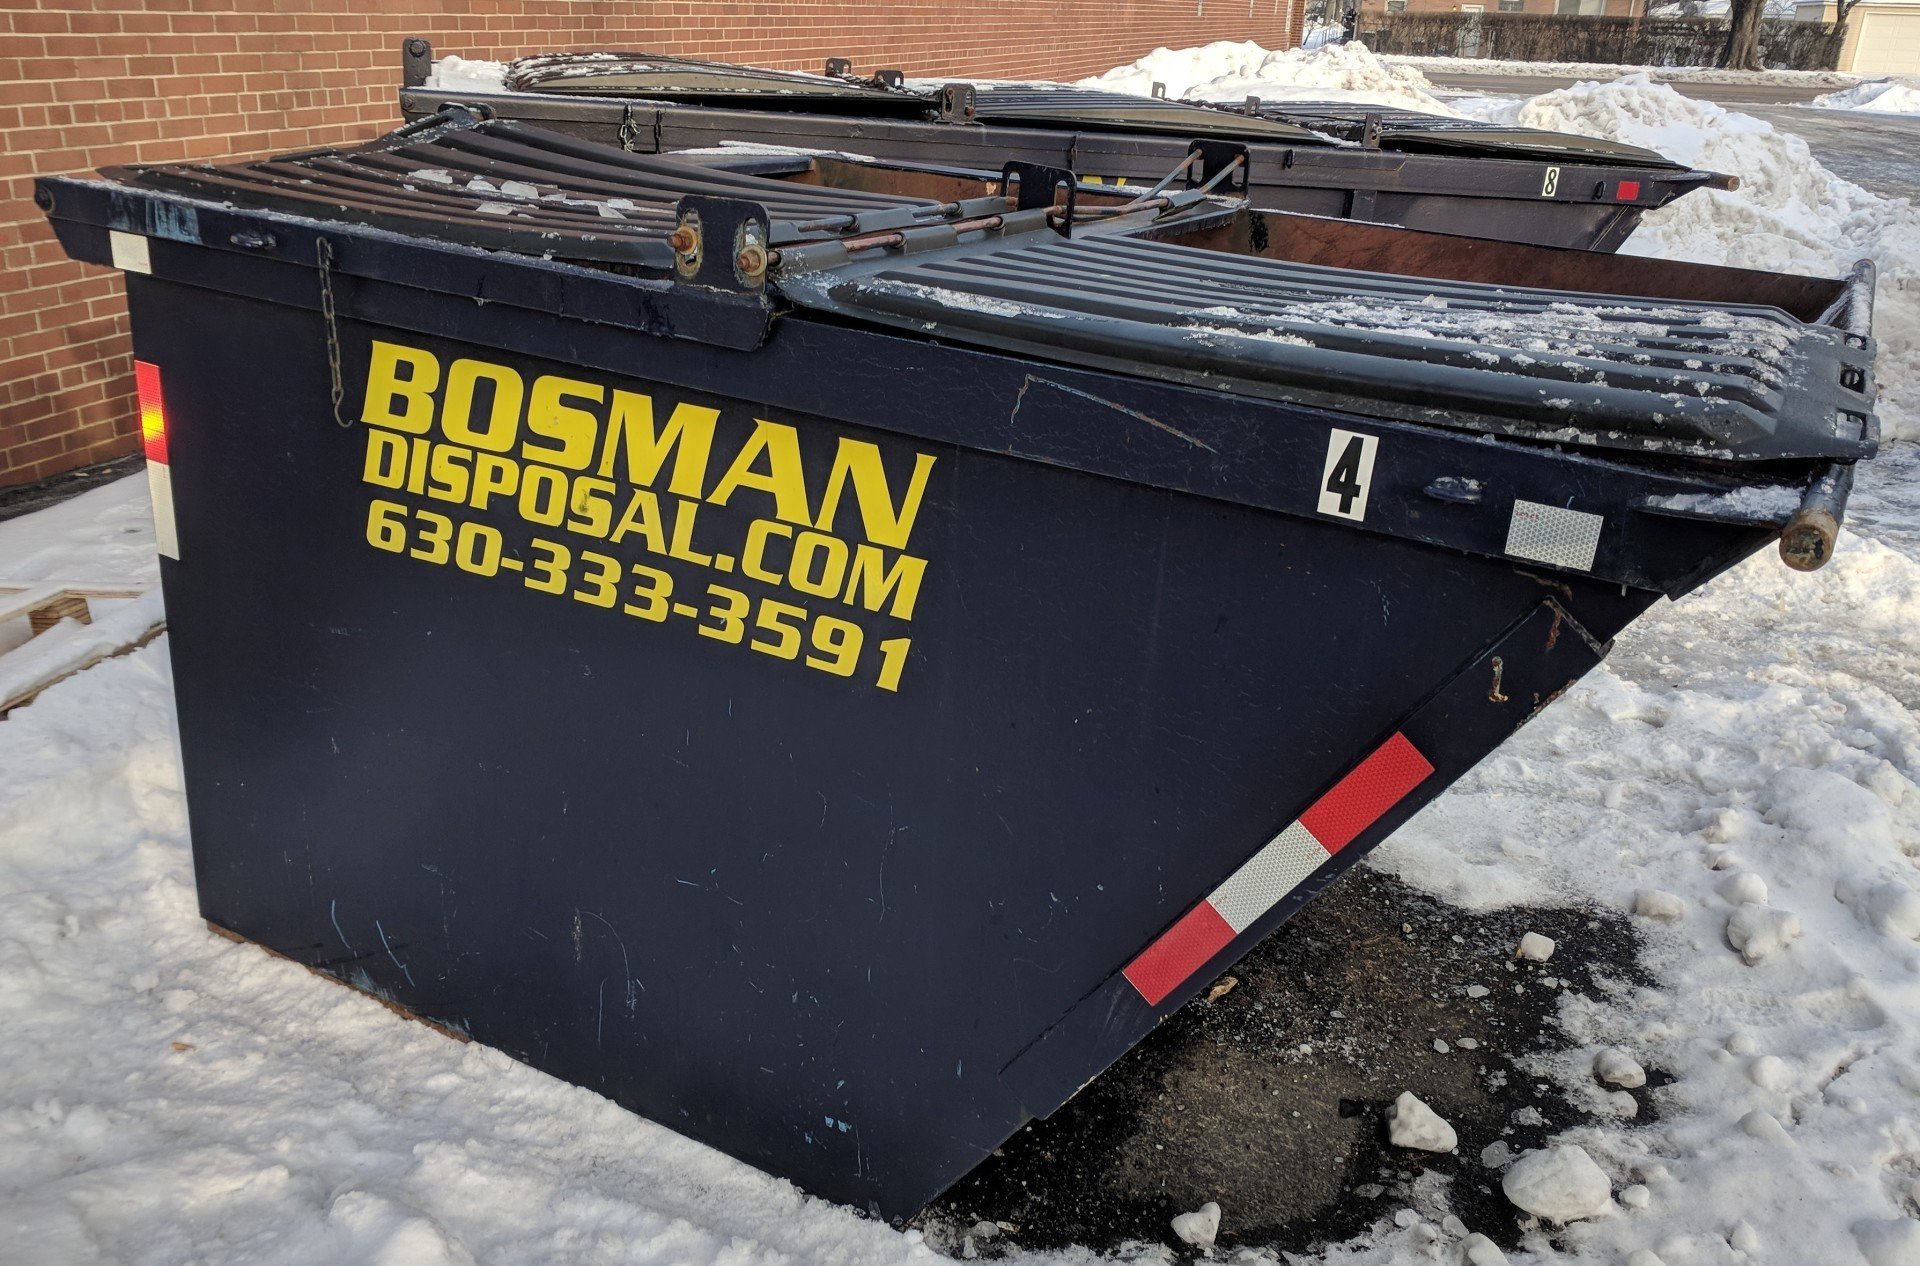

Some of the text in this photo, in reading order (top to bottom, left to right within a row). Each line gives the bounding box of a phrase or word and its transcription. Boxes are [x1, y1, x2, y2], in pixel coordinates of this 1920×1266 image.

[1544, 168, 1558, 196] 8
[361, 340, 937, 550] BOSMAN
[362, 428, 929, 621] DISPOSAL.COM
[1326, 435, 1365, 515] 4
[366, 499, 912, 692] 630-333-3591
